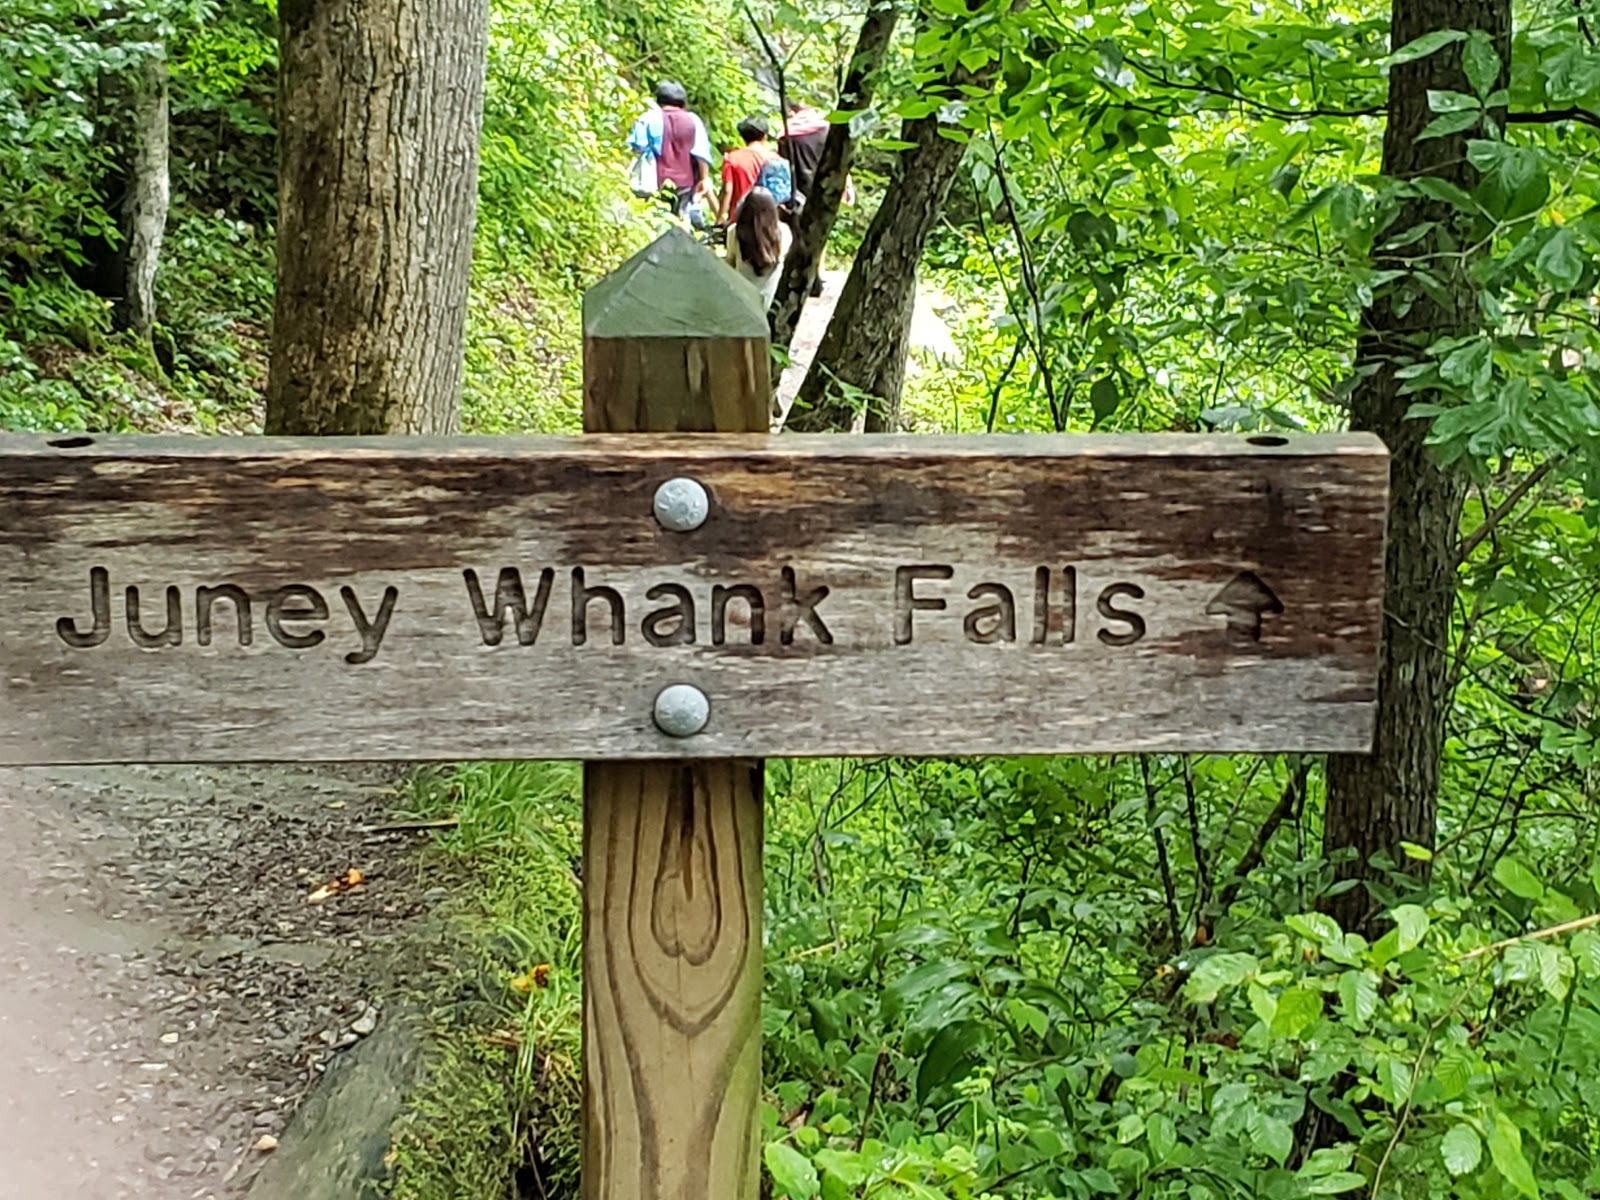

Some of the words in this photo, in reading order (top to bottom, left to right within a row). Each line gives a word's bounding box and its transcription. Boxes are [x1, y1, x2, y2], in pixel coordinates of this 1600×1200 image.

[56, 566, 399, 664] Juney
[464, 565, 834, 647] Whank
[895, 564, 1148, 647] Falls
